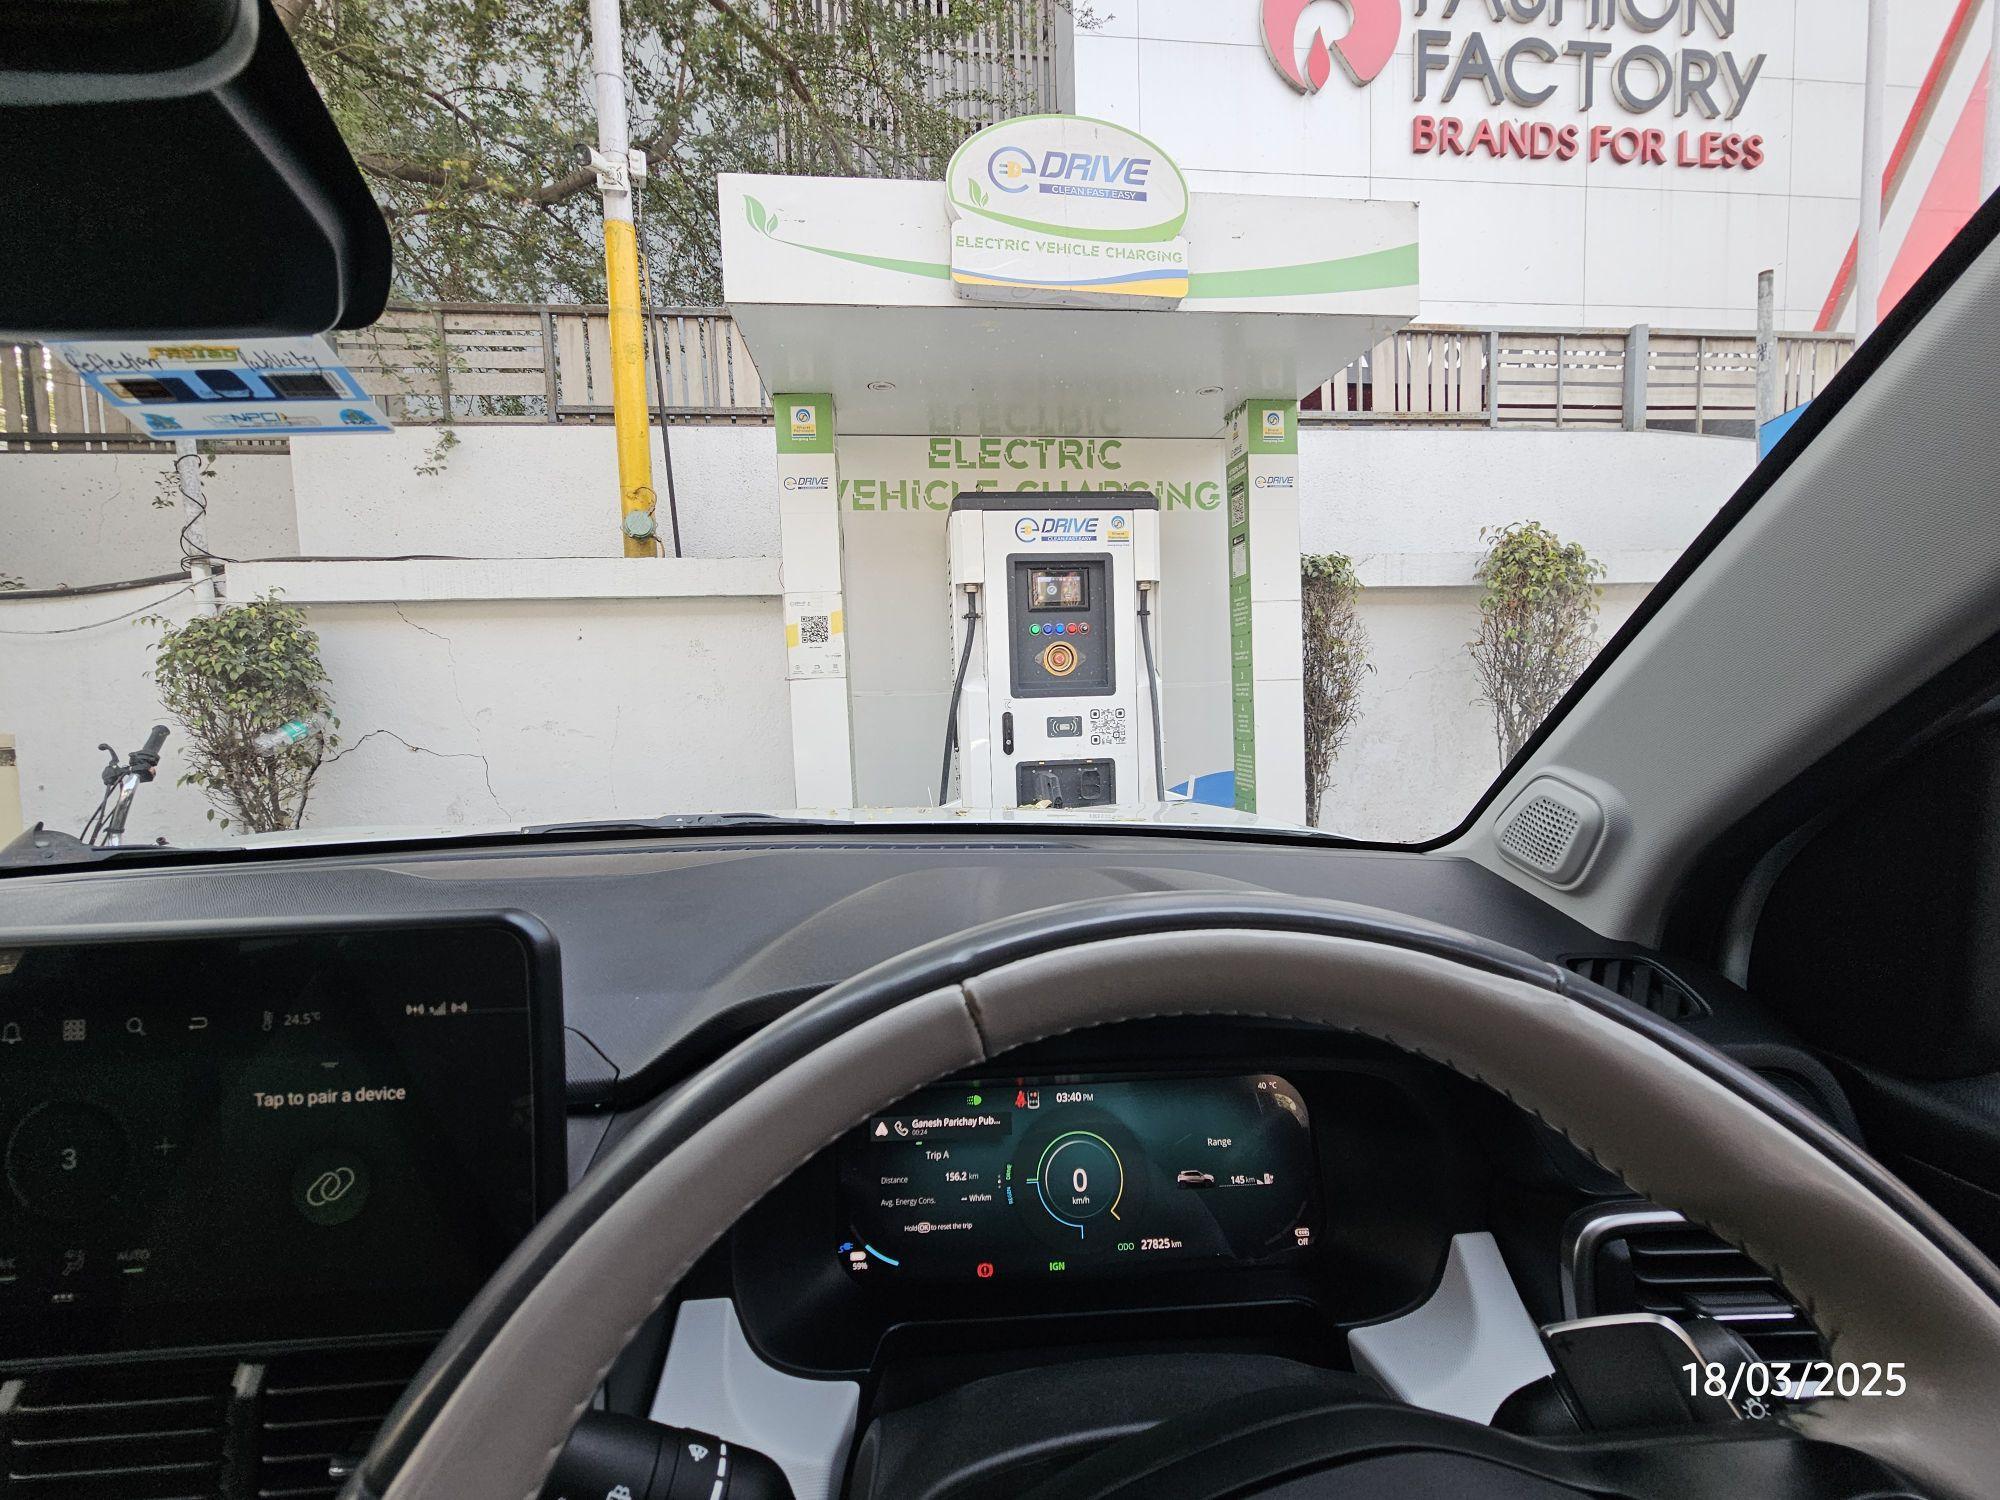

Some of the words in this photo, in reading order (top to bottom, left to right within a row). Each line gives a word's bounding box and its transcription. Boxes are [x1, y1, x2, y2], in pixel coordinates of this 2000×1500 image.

[1412, 29, 1768, 121] FACTORY
[1412, 115, 1579, 161] BRANDS
[1590, 125, 1667, 166] FOR
[1677, 130, 1765, 170] LESS
[955, 235, 1030, 252] ELECTRIC
[1036, 240, 1100, 257] VEHICLE
[1106, 247, 1184, 263] CHARGING
[927, 438, 1122, 470] ELECTRIC
[1258, 1082, 1267, 1090] 40
[254, 1091, 285, 1109] Tap
[288, 1091, 304, 1105] to
[307, 1089, 337, 1108] pair
[342, 1090, 351, 1103] a
[355, 1085, 406, 1102] device
[1056, 1091, 1082, 1103] 03:40
[1083, 1093, 1094, 1101] PM
[912, 1118, 942, 1129] Ganesh
[943, 1116, 977, 1129] Parichay
[1207, 1138, 1232, 1147] Range
[62, 1149, 77, 1171] 3
[925, 1150, 942, 1161] Trip
[943, 1150, 950, 1159] A
[881, 1176, 908, 1185] Distance
[945, 1171, 967, 1182] 156.2
[968, 1172, 979, 1180] km
[1072, 1168, 1088, 1193] 0
[1230, 1175, 1245, 1185] 145
[881, 1199, 894, 1208] Avg.
[896, 1198, 917, 1207] Energy
[918, 1197, 936, 1205] Cons.
[969, 1194, 992, 1202] Wh/km
[1072, 1196, 1090, 1205] km/h
[937, 1223, 952, 1231] reset
[962, 1222, 973, 1231] trip
[1117, 1242, 1135, 1251] ODO
[1141, 1238, 1171, 1250] 27825
[1171, 1240, 1182, 1248] km
[1297, 1238, 1309, 1246] Off
[852, 1262, 868, 1270] 59%
[1049, 1261, 1065, 1271] IGN
